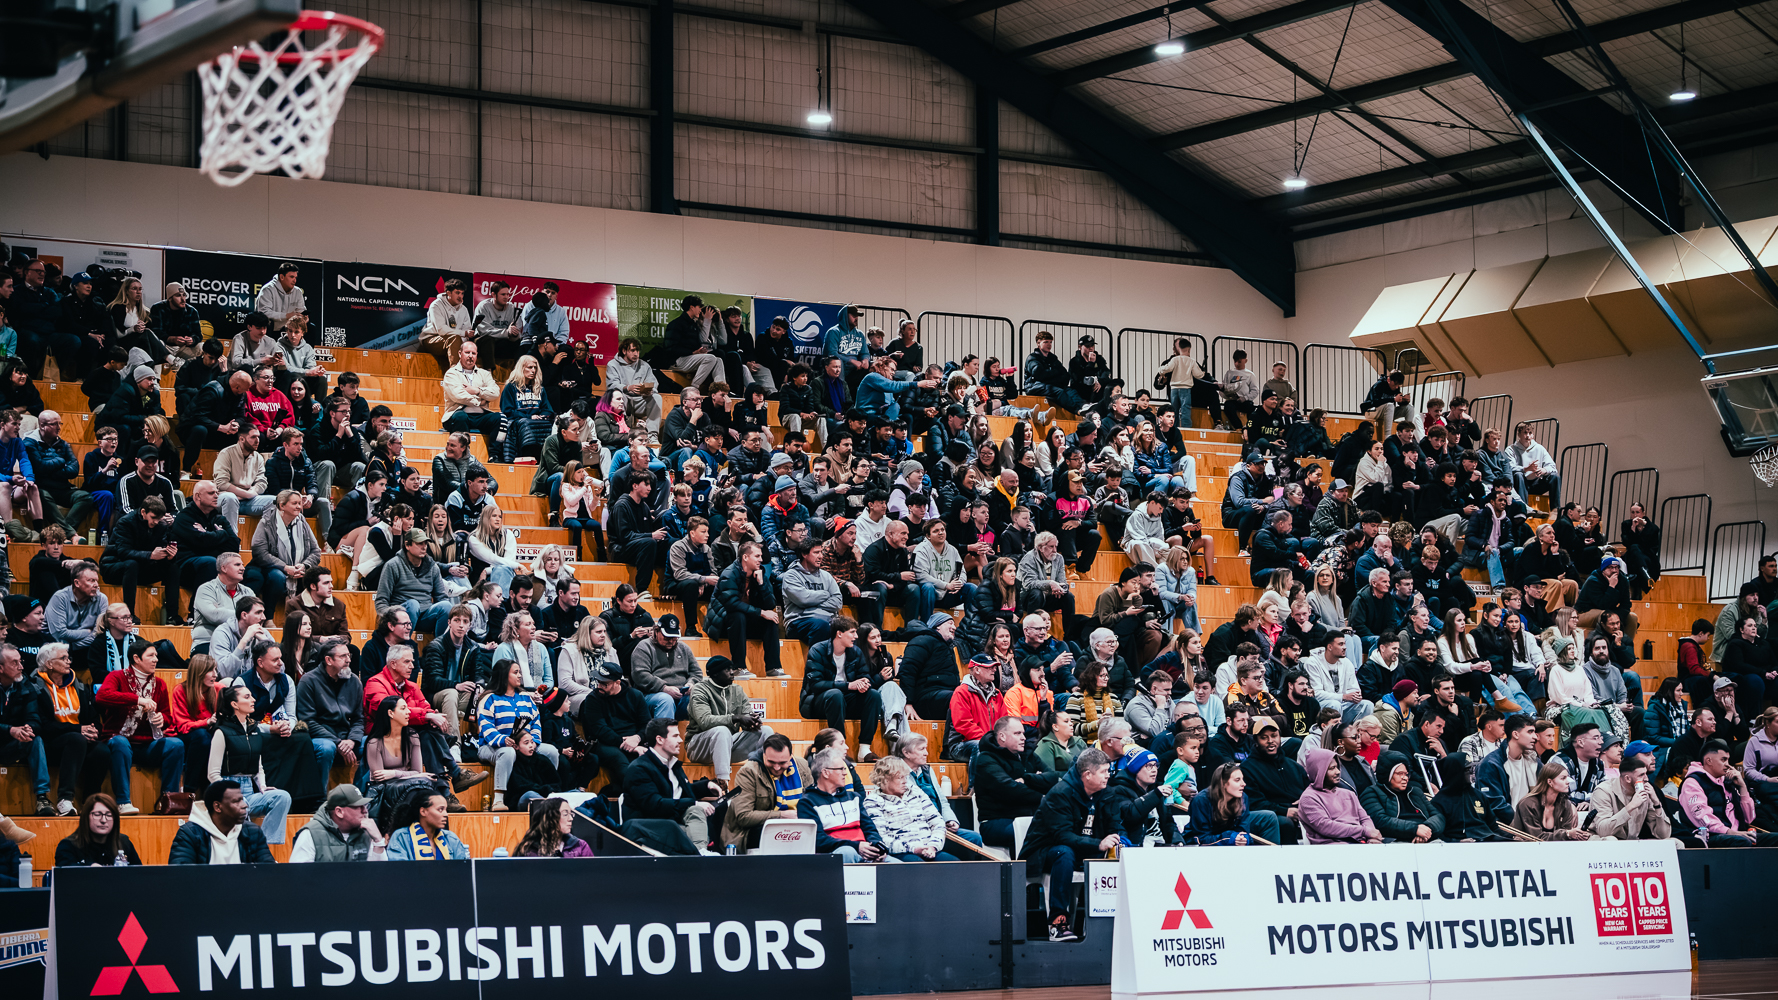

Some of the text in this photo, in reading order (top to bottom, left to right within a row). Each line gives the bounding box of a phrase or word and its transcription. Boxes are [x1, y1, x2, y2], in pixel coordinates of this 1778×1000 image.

[182, 277, 250, 294] RECOVER
[337, 274, 420, 295] NCM
[508, 284, 540, 302] you
[617, 294, 637, 308] THIS
[638, 296, 649, 309] IS
[617, 309, 668, 324] THIS IS LIFE
[794, 346, 823, 355] SKETBA
[800, 355, 815, 366] ACT
[603, 602, 609, 610] M
[1274, 869, 1557, 904] NATIONAL CAPITAL
[1595, 878, 1626, 907] 10
[1633, 877, 1664, 906] 10
[1599, 907, 1628, 918] YEARS
[1637, 906, 1666, 917] YEARS
[0, 932, 40, 945] NBERRA
[1267, 916, 1575, 955] MOTORS MITSUBISHI
[0, 939, 47, 960] UNNE
[1153, 936, 1225, 952] MITSUBISHI
[196, 918, 826, 992] MITSUBISHI MOTORS
[1165, 953, 1218, 967] MOTORS
